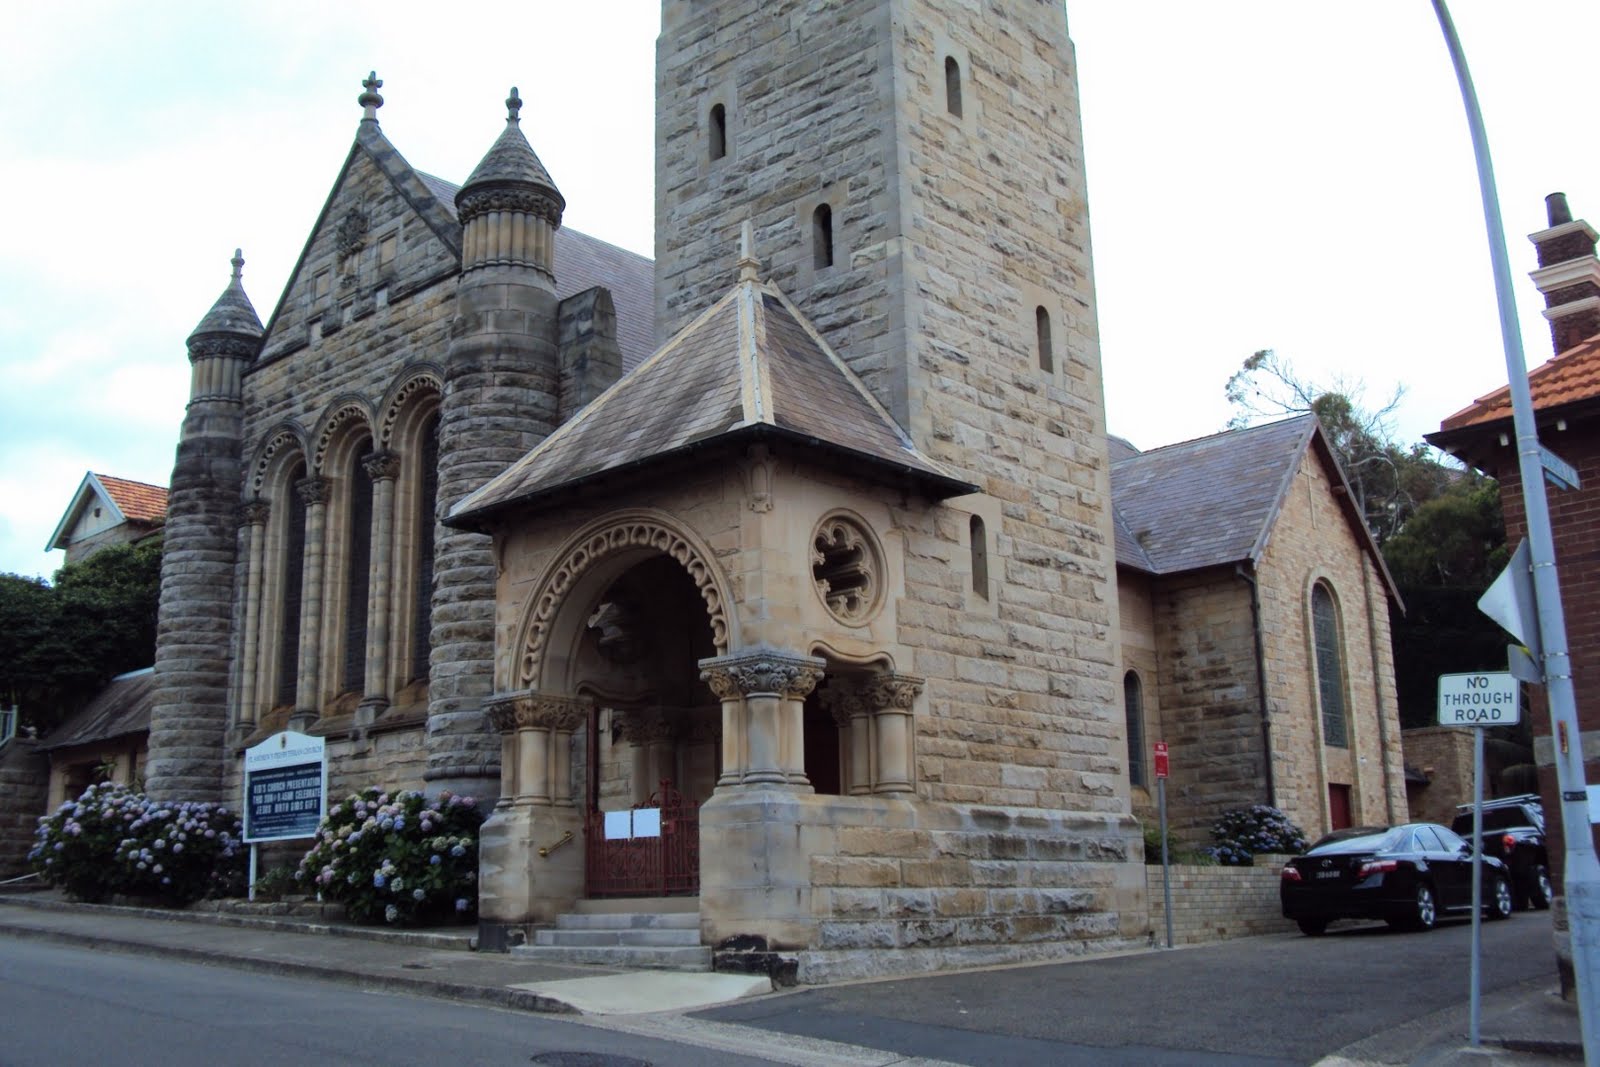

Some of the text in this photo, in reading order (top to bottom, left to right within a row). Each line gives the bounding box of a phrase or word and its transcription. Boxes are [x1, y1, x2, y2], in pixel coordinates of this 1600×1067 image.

[1466, 677, 1489, 689] NO
[1443, 692, 1513, 705] THROUGH
[1455, 708, 1502, 721] ROAD
[267, 781, 285, 792] CHURCH
[286, 777, 320, 789] PRESENTATION
[295, 788, 321, 799] CELEBRATE
